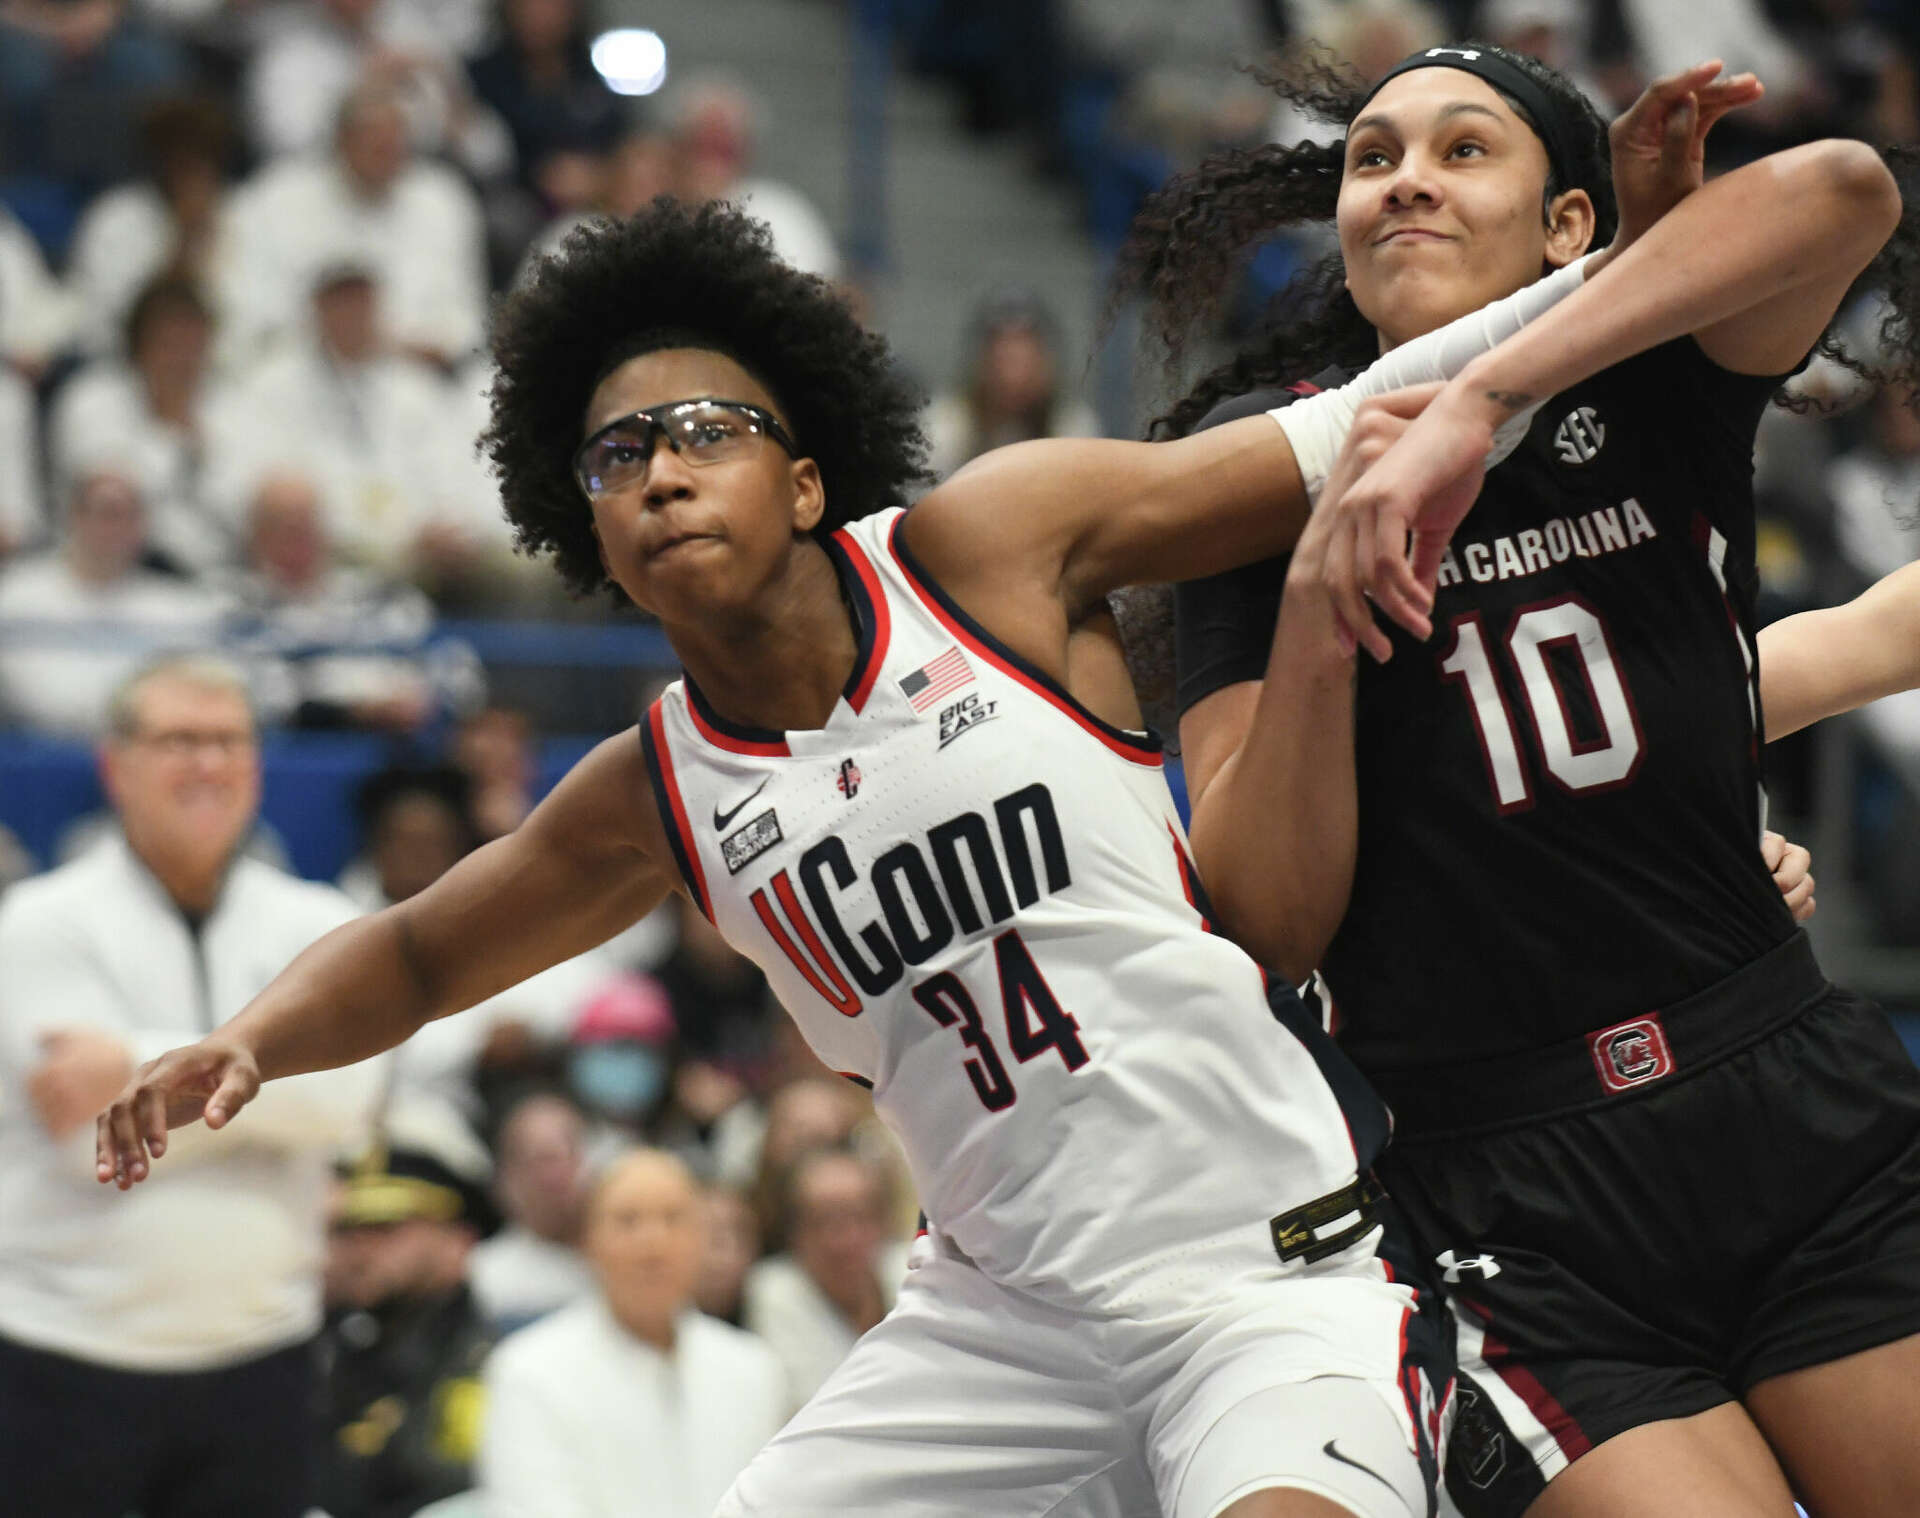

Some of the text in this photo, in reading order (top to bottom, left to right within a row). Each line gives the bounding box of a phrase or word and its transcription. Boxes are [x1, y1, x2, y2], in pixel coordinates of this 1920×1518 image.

[1554, 406, 1606, 464] SEC
[1464, 497, 1657, 582] CAROLINA
[939, 692, 979, 726] BIG
[939, 700, 998, 741] EAST
[1439, 596, 1645, 812] 10
[912, 928, 1091, 1113] 34
